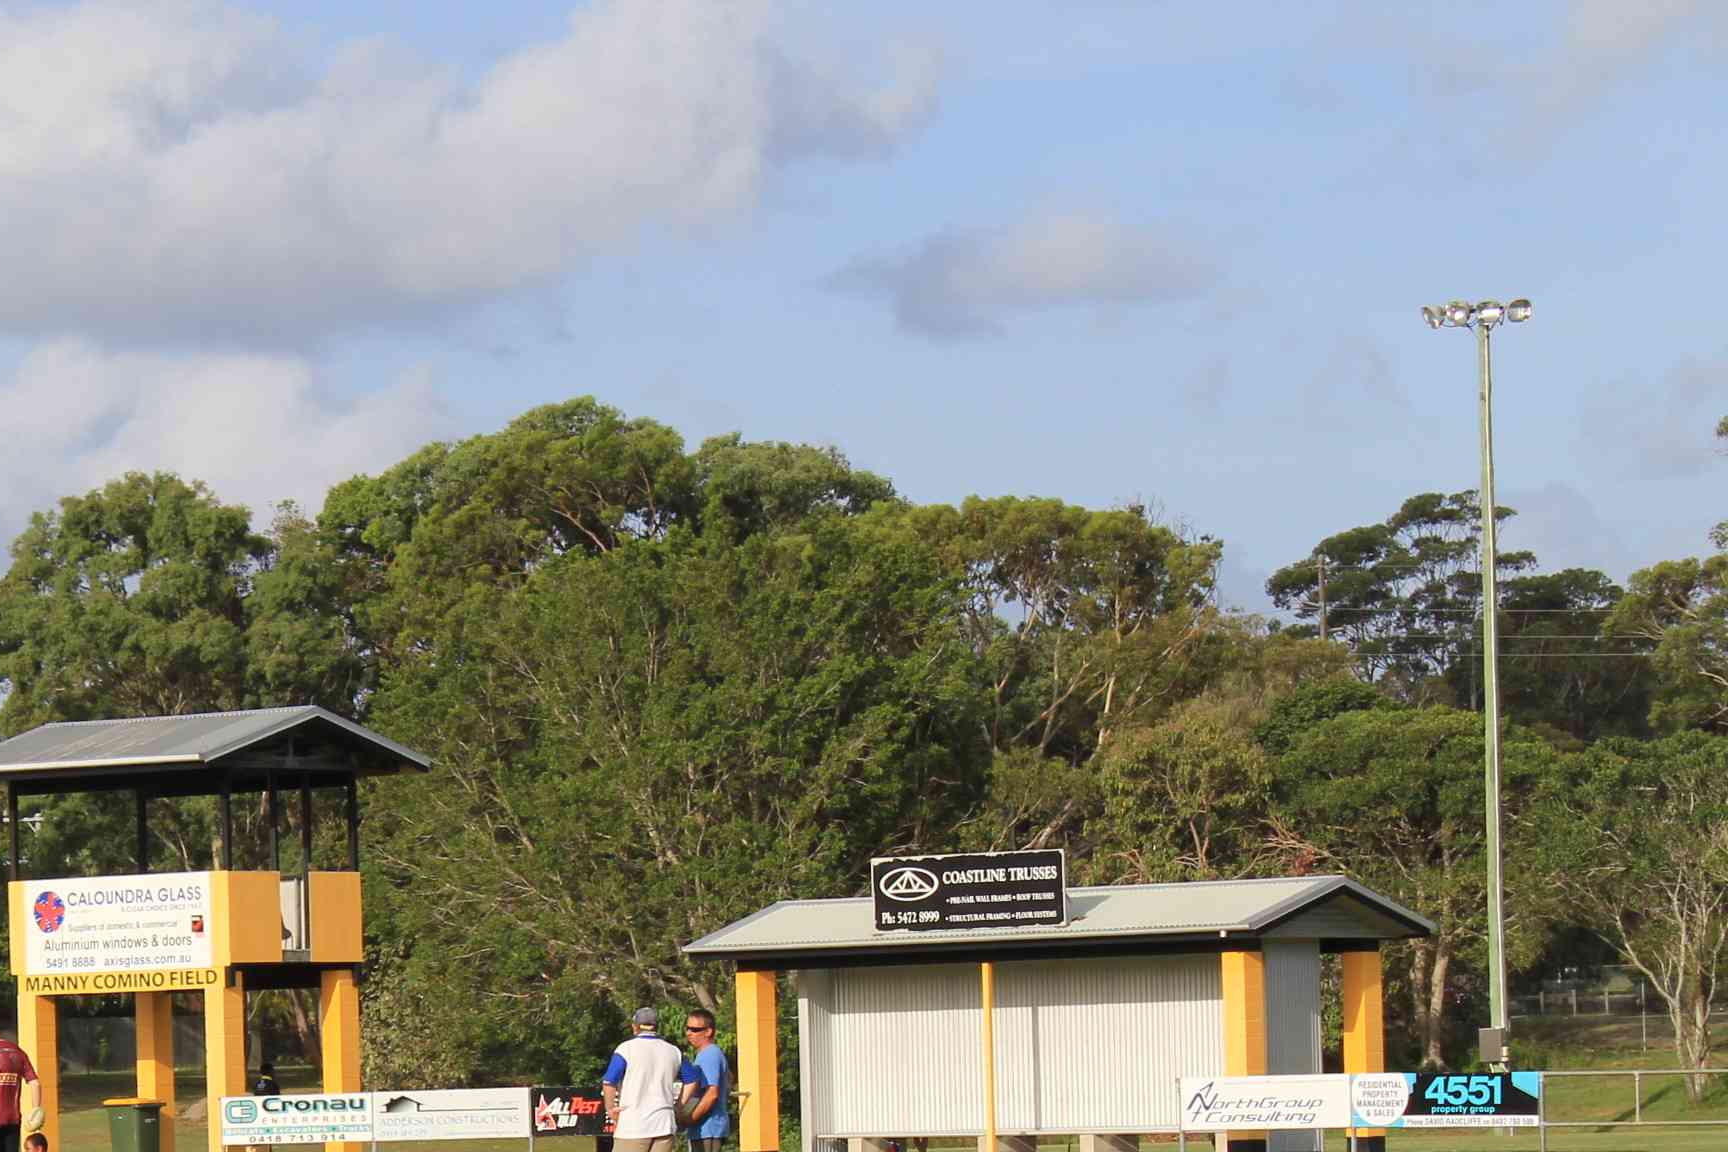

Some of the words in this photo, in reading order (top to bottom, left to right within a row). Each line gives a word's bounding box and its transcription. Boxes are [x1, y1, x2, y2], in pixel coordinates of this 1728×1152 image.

[943, 868, 1007, 885] COASTLINE
[1008, 866, 1058, 881] TRUSSES
[67, 889, 154, 907] CALOUNDRA
[157, 886, 202, 902] GLASS
[881, 911, 895, 925] Ph:
[897, 911, 917, 924] 5472
[44, 938, 100, 952] Aluminium
[103, 936, 149, 949] windows
[151, 934, 160, 948] &
[163, 934, 193, 947] doors
[104, 953, 192, 968] axisglass.com.au
[26, 975, 90, 992] MANNY
[93, 972, 164, 989] COMINO
[169, 969, 218, 986] FIELD
[1425, 1076, 1502, 1105] 4551
[262, 1096, 367, 1113] Cronau
[1431, 1105, 1468, 1114] property
[1469, 1105, 1496, 1114] group
[261, 1114, 368, 1124] ENTERPRISES
[1205, 1110, 1318, 1125] Consulting
